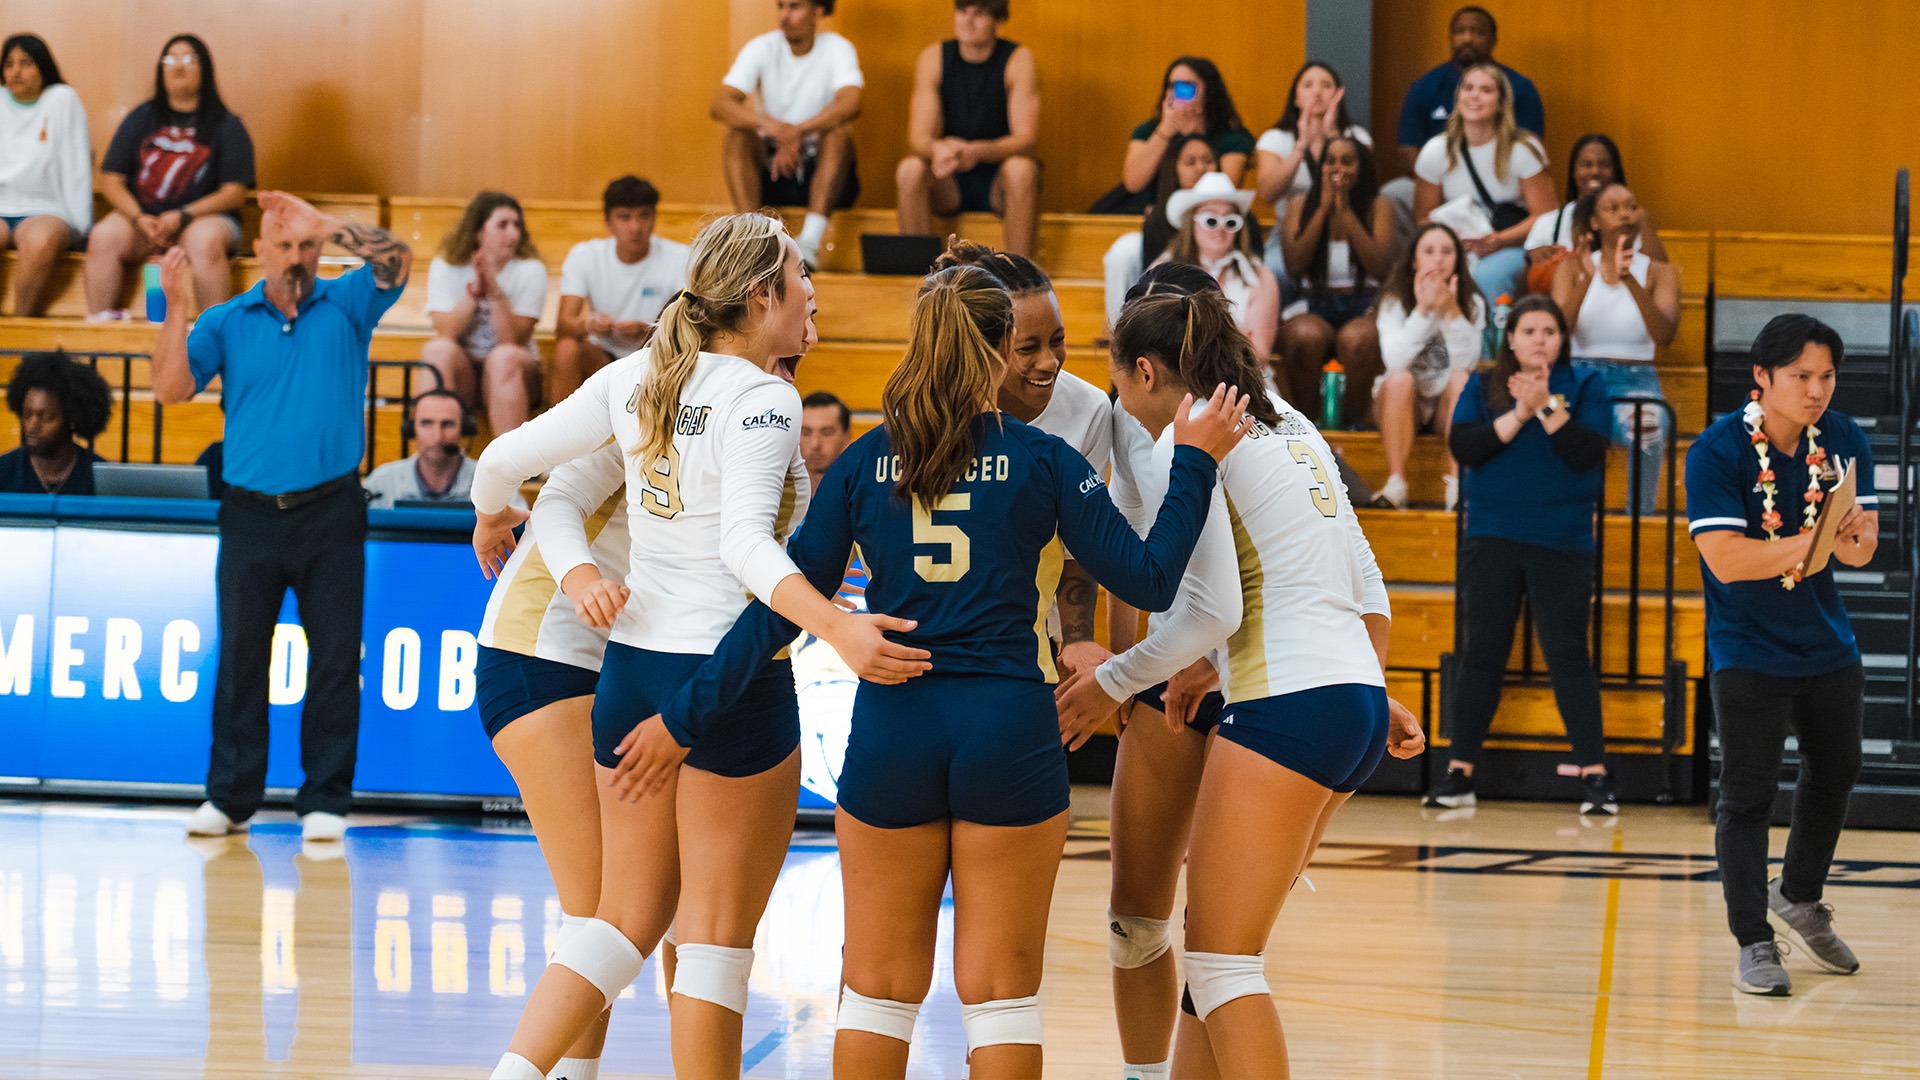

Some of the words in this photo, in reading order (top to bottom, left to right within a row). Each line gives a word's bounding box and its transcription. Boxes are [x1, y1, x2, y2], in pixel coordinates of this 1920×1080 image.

[742, 416, 766, 426] CAL
[769, 414, 792, 428] PAC
[641, 443, 684, 520] 9
[956, 455, 1009, 482] CED
[1286, 439, 1337, 518] 3
[912, 492, 971, 583] 5
[0, 613, 309, 705] MERCD
